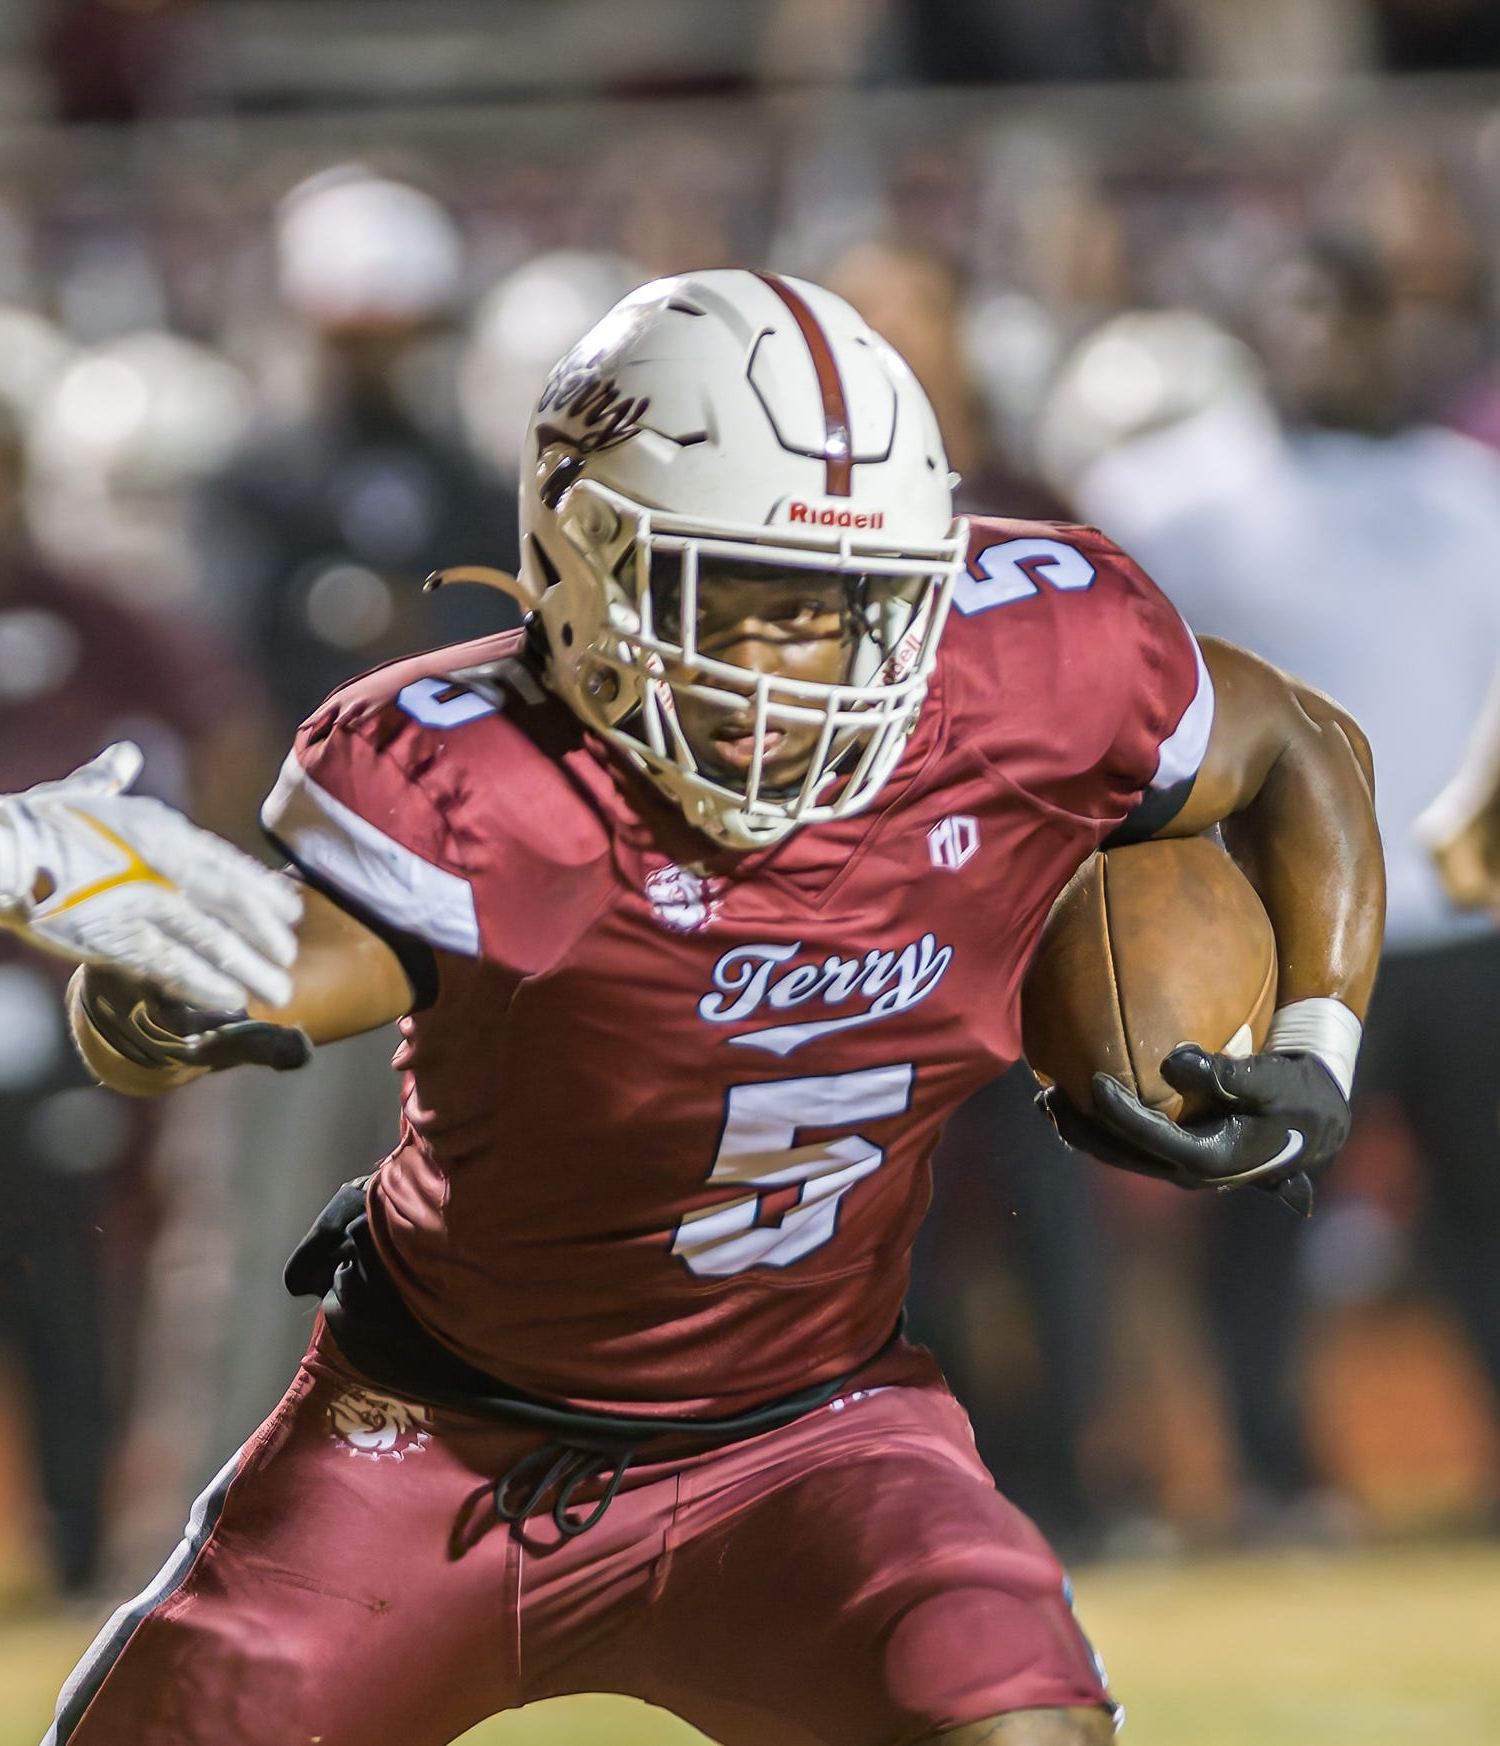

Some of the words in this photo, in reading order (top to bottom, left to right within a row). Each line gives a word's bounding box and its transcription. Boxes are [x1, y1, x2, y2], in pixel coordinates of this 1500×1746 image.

[789, 501, 884, 530] Riddell
[949, 537, 1097, 617] 5
[698, 932, 955, 1056] Terry
[670, 1062, 916, 1278] 5
